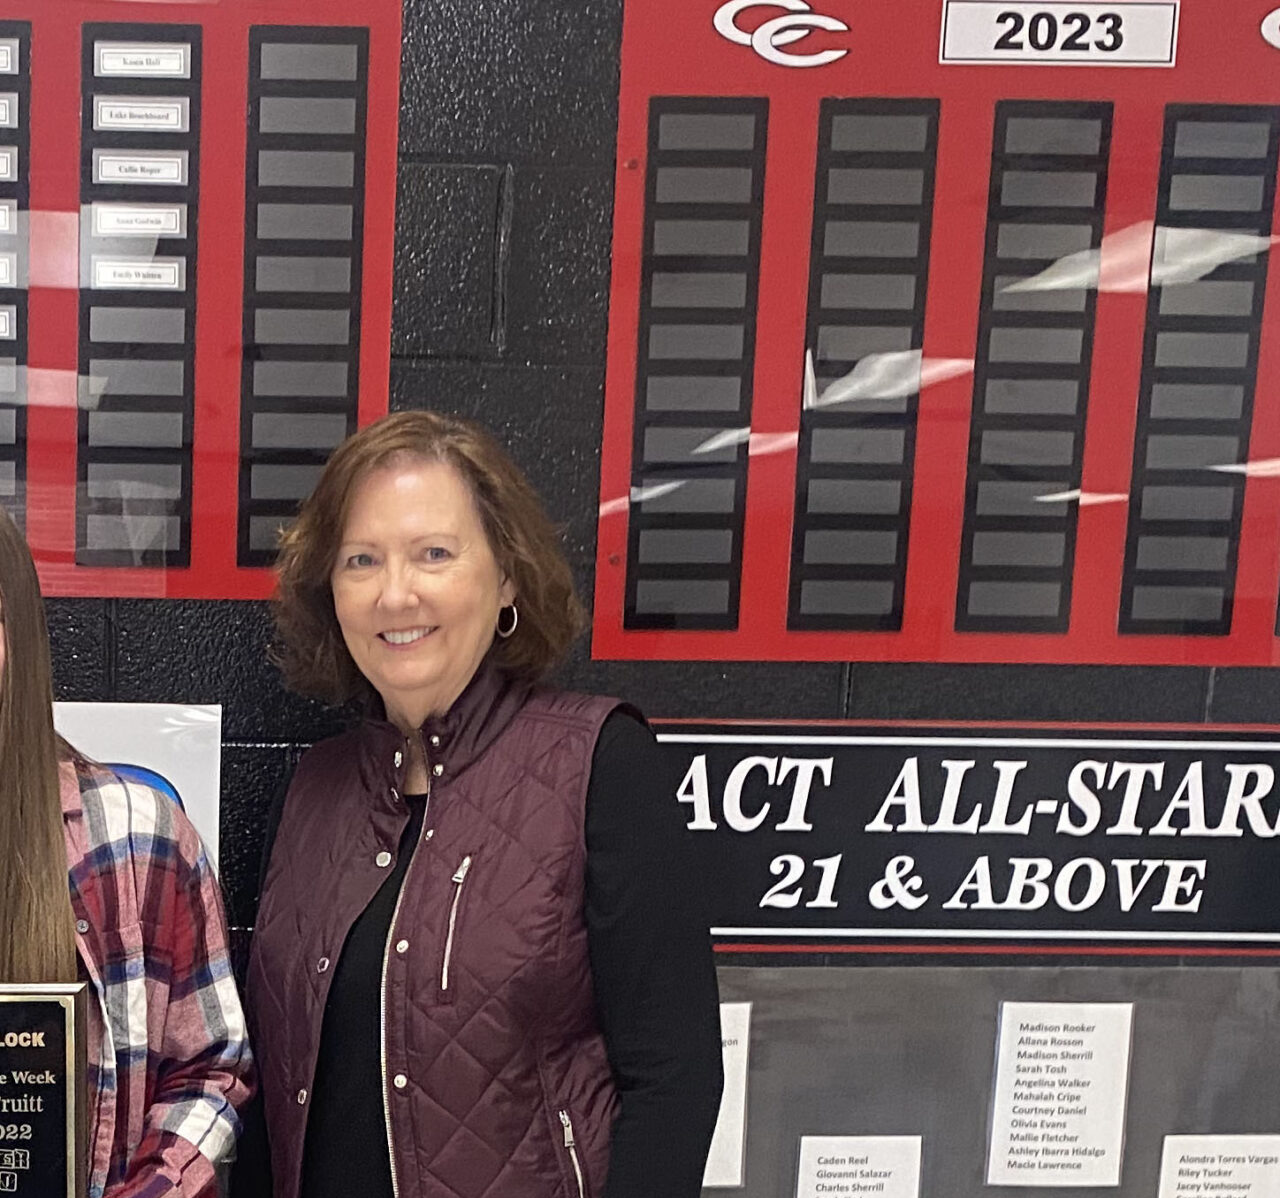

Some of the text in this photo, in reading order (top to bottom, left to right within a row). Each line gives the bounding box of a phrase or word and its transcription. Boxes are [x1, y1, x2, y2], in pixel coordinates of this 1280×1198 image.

[994, 12, 1124, 51] 2023
[675, 754, 1280, 839] ACT ALL-STAR
[758, 853, 1209, 913] 21 & ABOVE
[1019, 1023, 1060, 1032] Madison
[1017, 1051, 1093, 1060] Madison Sherrill
[1016, 1064, 1067, 1074] Sarah Tosh
[12, 1071, 56, 1084] Week
[1014, 1078, 1090, 1089] Angelina Walker
[1012, 1105, 1087, 1116] Courtney Daniel
[1011, 1119, 1067, 1129] Olivia Evans
[1041, 1133, 1079, 1142] Fletcher
[1008, 1146, 1039, 1157] Ashley
[817, 1156, 868, 1165] Caden Reel
[1218, 1155, 1246, 1163] Torres
[1248, 1156, 1278, 1164] Vargas
[1038, 1160, 1082, 1169] Lawrence
[816, 1170, 892, 1179] Giovanni Salazar
[1202, 1169, 1232, 1177] Tucker
[816, 1183, 884, 1192] Charles Sherrill
